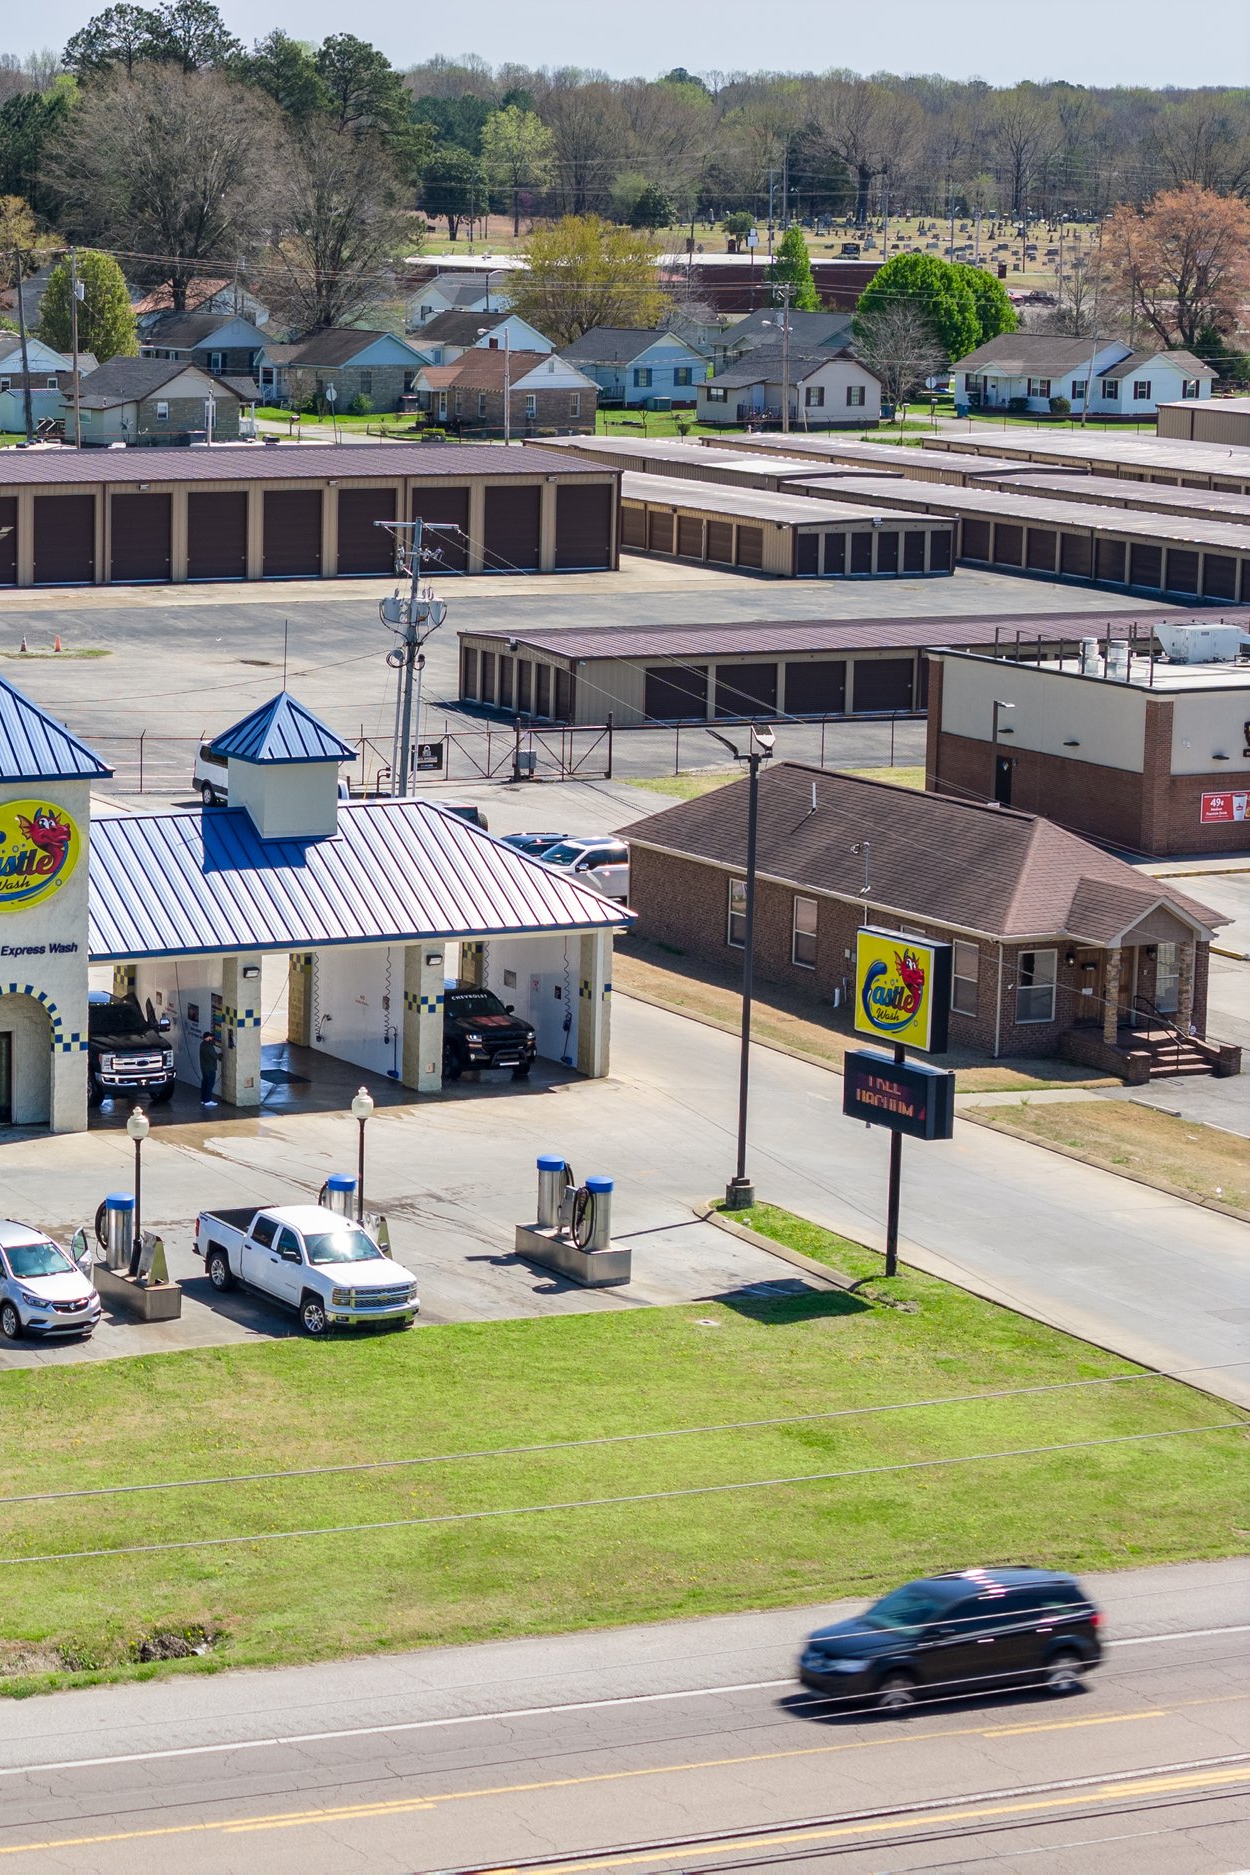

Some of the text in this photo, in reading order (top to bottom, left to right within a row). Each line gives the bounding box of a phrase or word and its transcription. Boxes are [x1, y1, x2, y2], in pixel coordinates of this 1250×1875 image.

[0, 945, 46, 958] Express
[49, 942, 78, 954] Wash
[862, 960, 916, 1027] Castle
[876, 1007, 900, 1021] Wash
